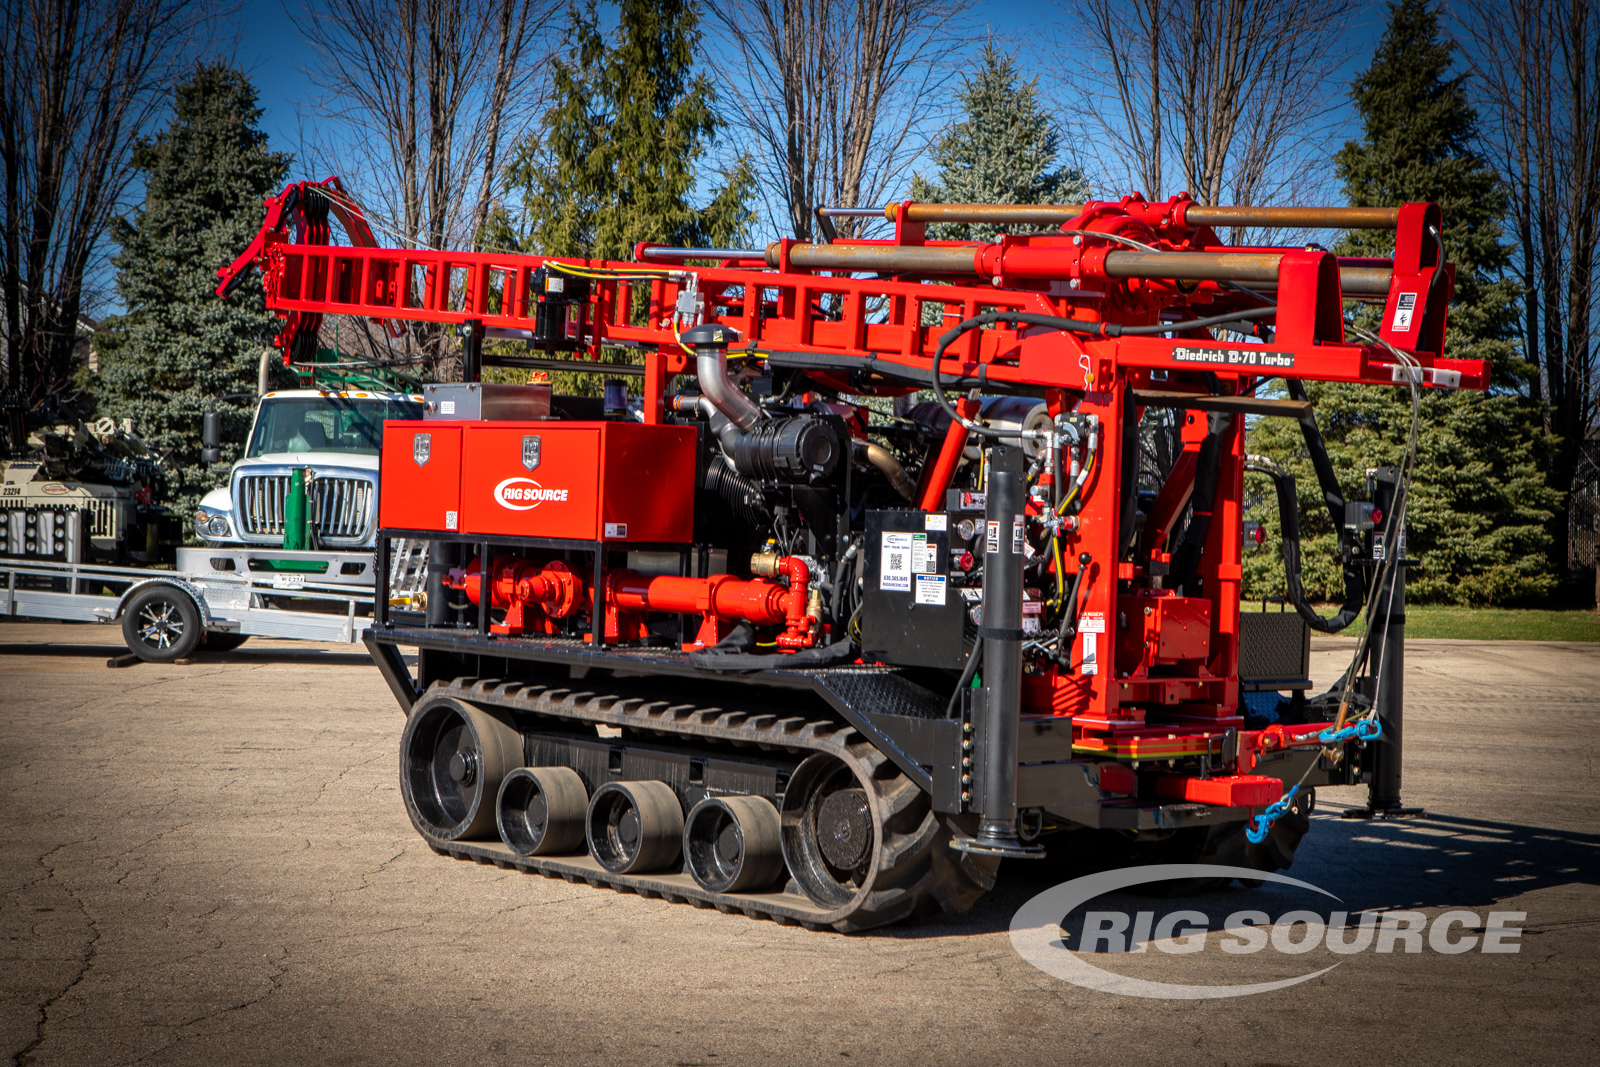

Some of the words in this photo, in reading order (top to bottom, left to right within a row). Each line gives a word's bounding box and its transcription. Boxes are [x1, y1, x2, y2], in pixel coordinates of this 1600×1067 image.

[1175, 347, 1224, 362] Diedrich
[1260, 352, 1291, 366] Turbo
[504, 488, 523, 500] RIG
[523, 488, 568, 502] SOURCE
